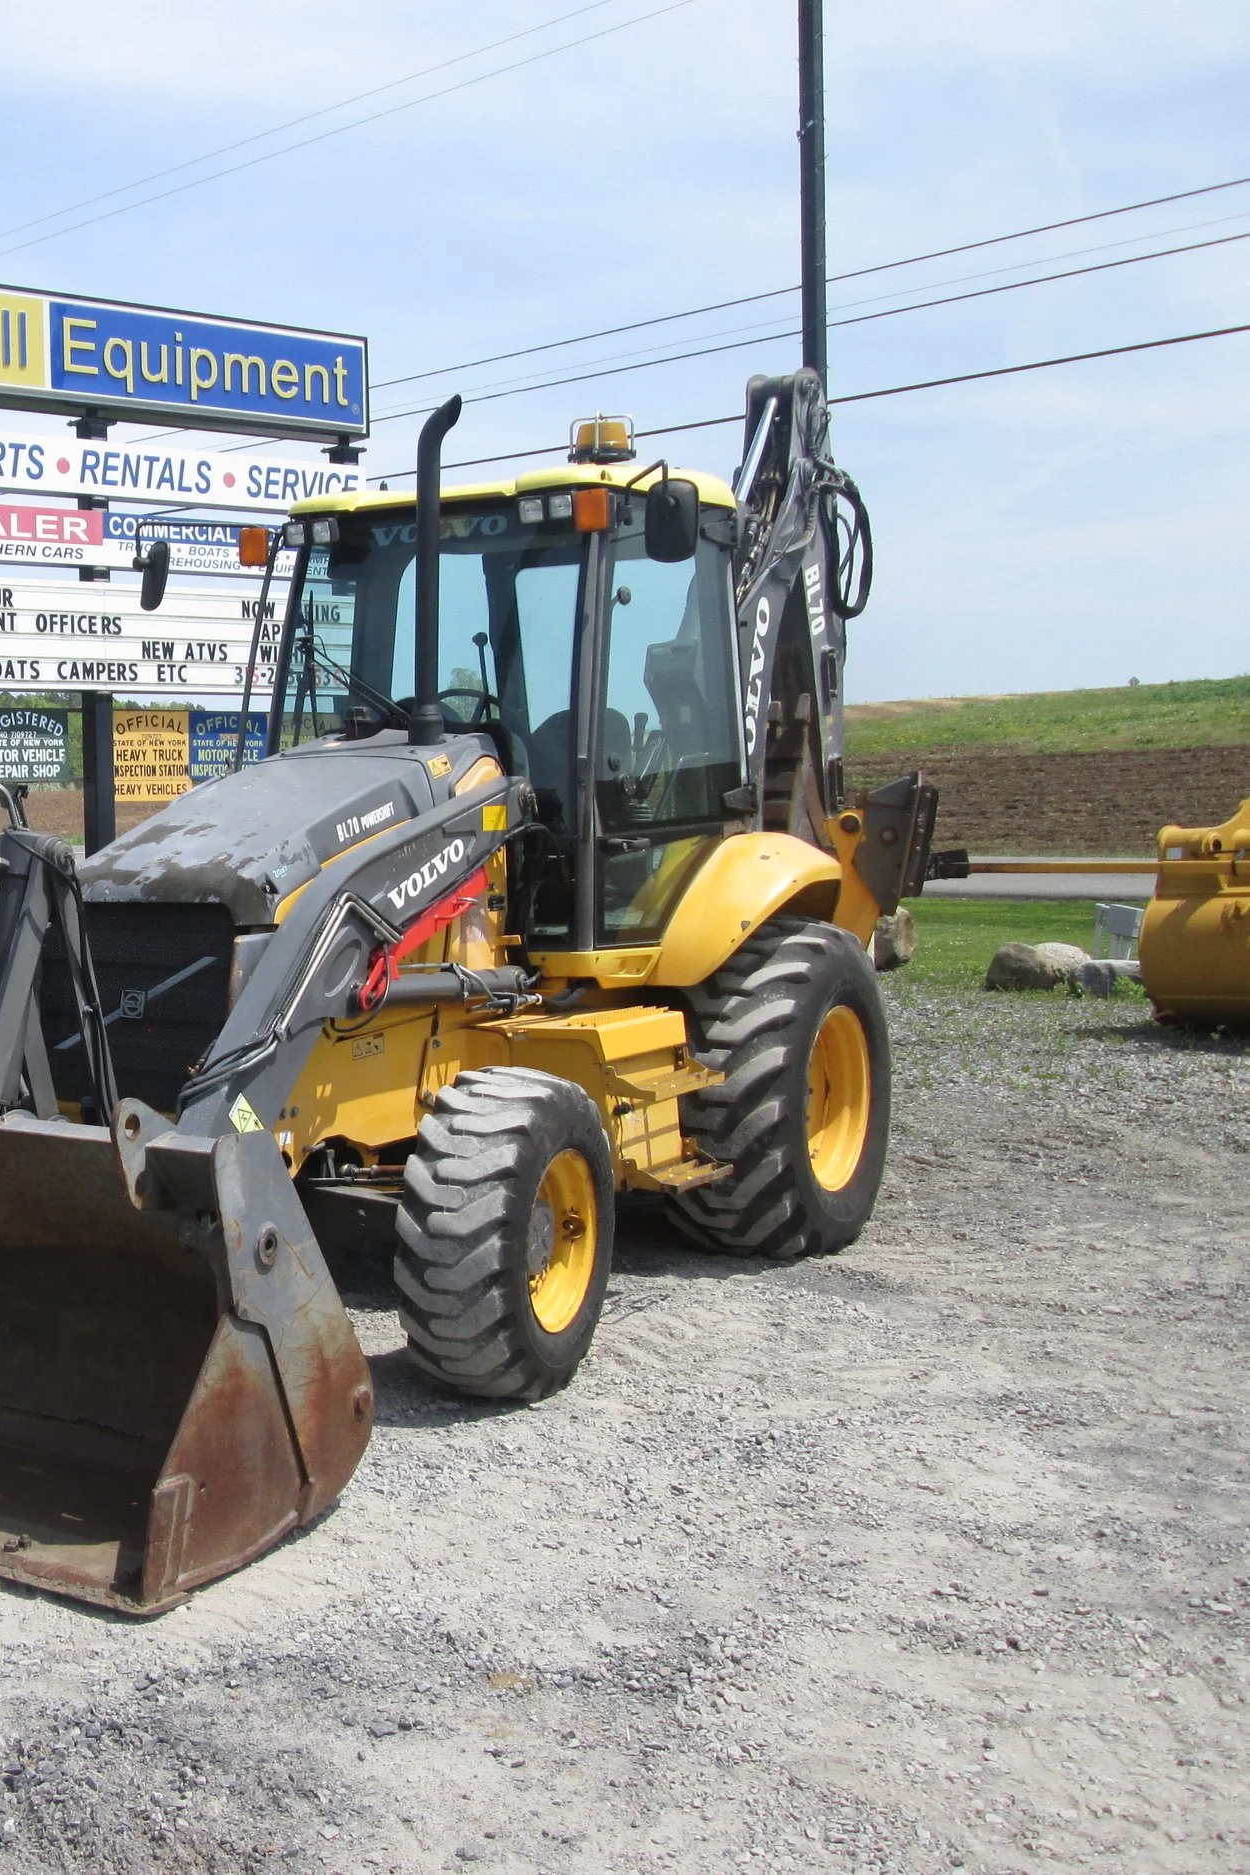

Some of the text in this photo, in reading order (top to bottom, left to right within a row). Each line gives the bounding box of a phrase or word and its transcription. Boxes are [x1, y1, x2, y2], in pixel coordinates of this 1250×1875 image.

[62, 317, 349, 406] Equipment
[79, 450, 212, 495] RENTALS
[109, 516, 237, 544] COMMERCIAL
[372, 515, 507, 547] VOVO
[41, 546, 84, 560] CARS
[188, 546, 230, 558] BOATS
[169, 557, 241, 570] REHOUSING
[805, 563, 826, 636] BL70
[242, 600, 275, 619] NOW
[36, 613, 122, 635] OFFICERS
[142, 641, 174, 660] NEW
[185, 643, 228, 662] ATVS
[57, 661, 138, 682] CAMPERS
[157, 664, 187, 683] ETC
[746, 597, 770, 756] OLVO
[116, 715, 184, 735] OFFICIAL
[196, 716, 262, 736] OFFICAL
[10, 739, 20, 747] OF
[23, 739, 41, 747] NEW
[44, 739, 64, 747] YORK
[113, 739, 186, 747] STATE OF NEW YORK
[245, 739, 263, 747] YORK
[22, 749, 65, 762] VEHICLE
[116, 748, 183, 761] HEAVY TRUCK
[198, 750, 258, 762] MOTORCCLE
[33, 764, 60, 777] SHOP
[114, 764, 189, 777] NSPECTION STATION
[115, 783, 187, 795] HEAVY VEHICLES
[336, 801, 395, 842] BL70 POWERSHIFT
[387, 838, 465, 909] VOLVO
